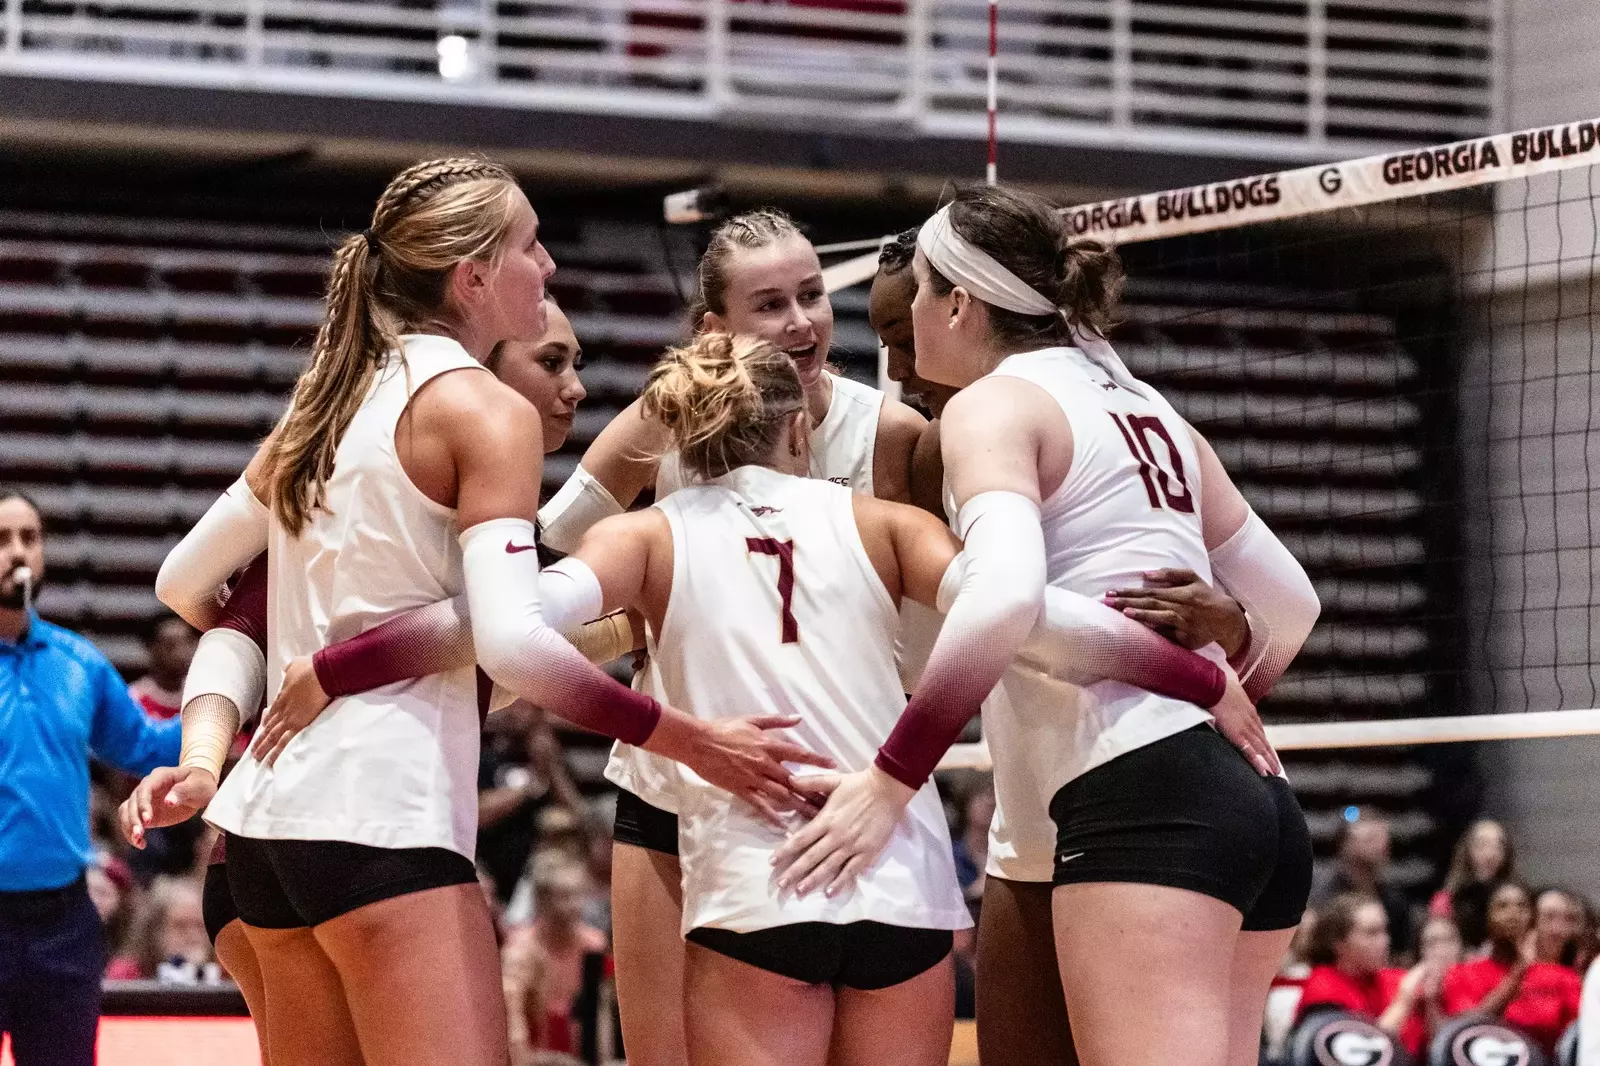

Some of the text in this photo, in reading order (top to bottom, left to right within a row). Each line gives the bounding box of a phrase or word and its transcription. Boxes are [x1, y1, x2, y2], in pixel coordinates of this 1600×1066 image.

[1319, 167, 1342, 195] G
[1383, 121, 1600, 185] GEORGIA BULLD
[1157, 177, 1280, 223] BULLDOGS
[1108, 411, 1195, 513] 10
[745, 537, 799, 644] 7
